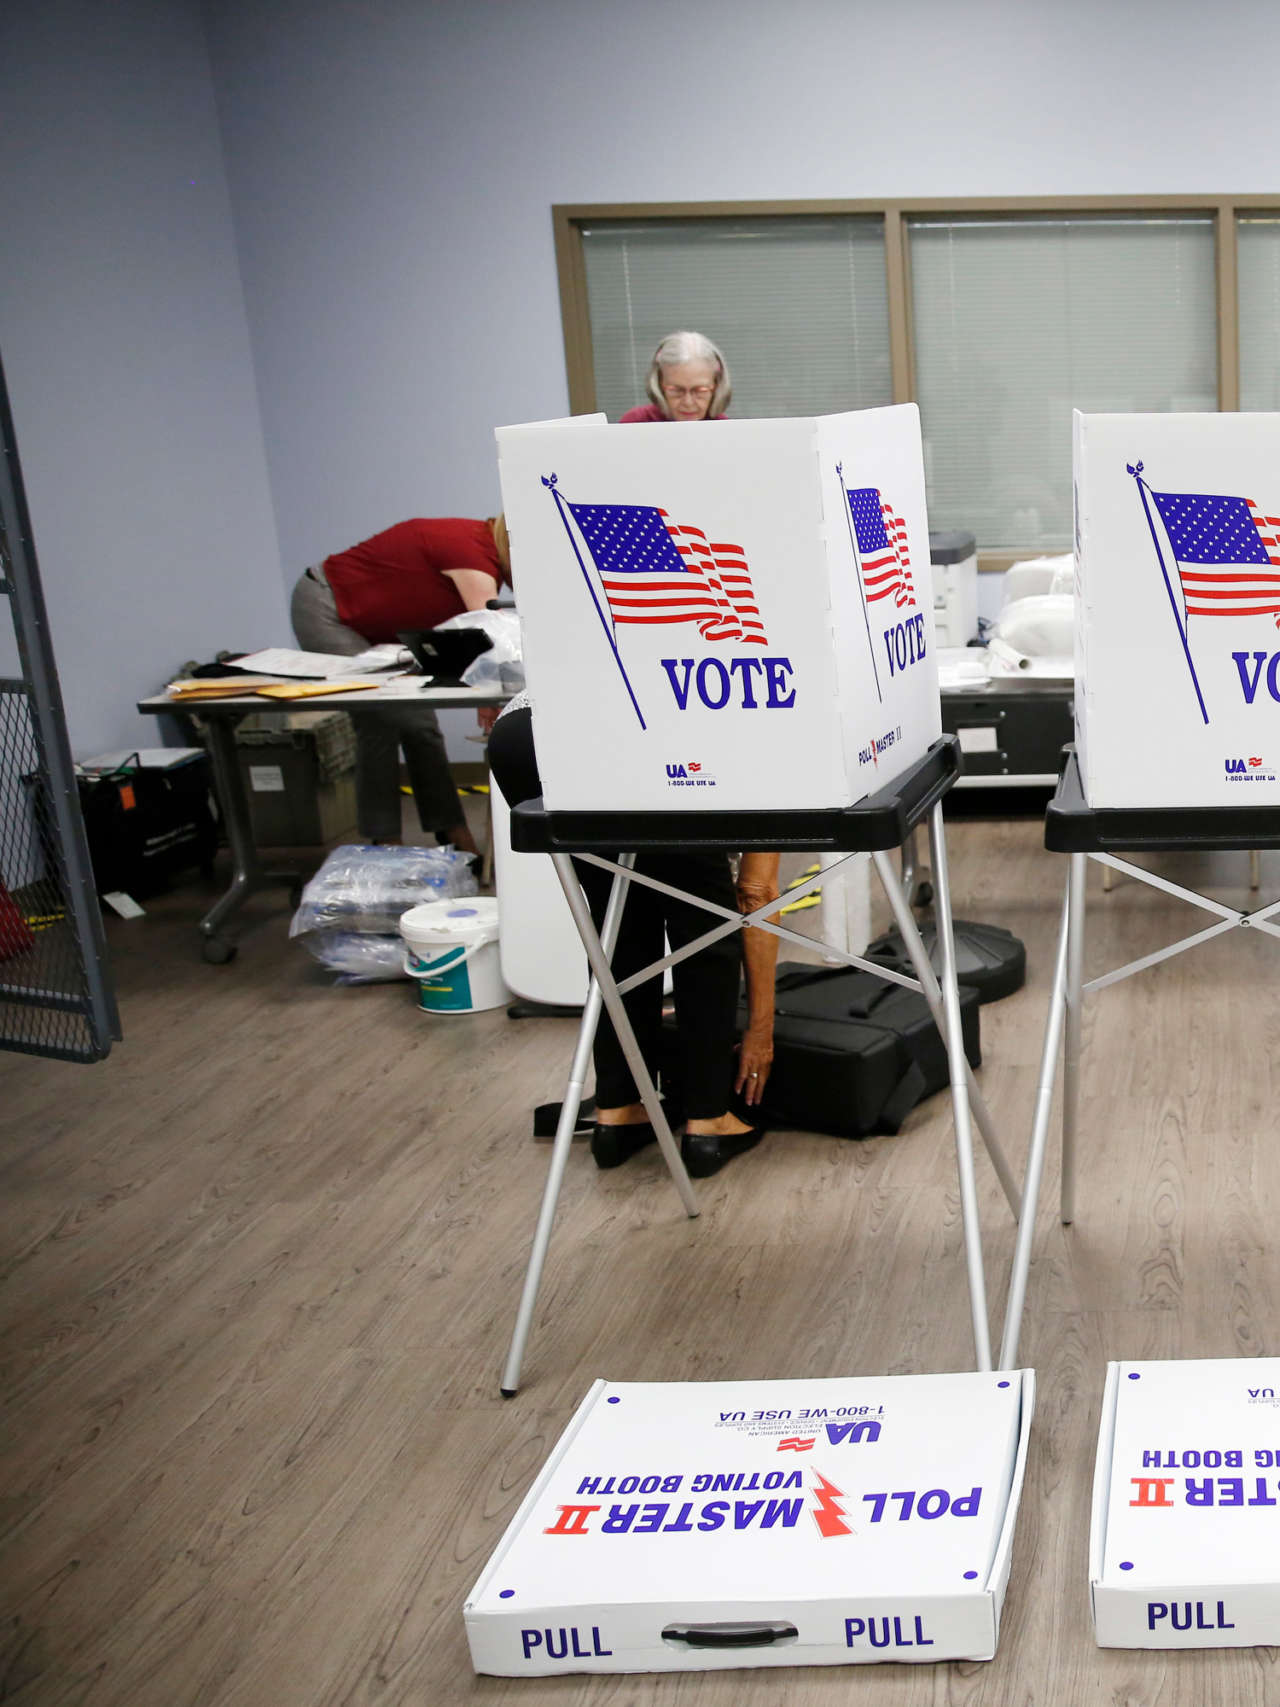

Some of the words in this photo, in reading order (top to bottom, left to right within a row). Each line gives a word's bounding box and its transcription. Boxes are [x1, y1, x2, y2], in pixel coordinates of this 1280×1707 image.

[884, 613, 926, 677] VOTE
[660, 657, 797, 710] VOTE
[858, 745, 872, 767] POLL
[876, 730, 895, 755] MASTER
[665, 764, 688, 779] UA
[1225, 759, 1247, 773] UA
[1248, 1388, 1275, 1398] UA
[720, 1411, 746, 1421] UA
[751, 1409, 792, 1421] USE
[798, 1405, 885, 1419] 1-800-WE
[826, 1420, 882, 1446] UA
[1142, 1450, 1243, 1469] BOOTH
[576, 1475, 684, 1495] BOOTH
[691, 1470, 803, 1492] VOTING
[1129, 1478, 1175, 1507] II
[601, 1498, 804, 1534] MASTER
[863, 1487, 983, 1523] POLL
[542, 1504, 601, 1535] II
[1148, 1600, 1236, 1630] PULL
[521, 1626, 613, 1659] PULL
[845, 1616, 934, 1648] PULL
